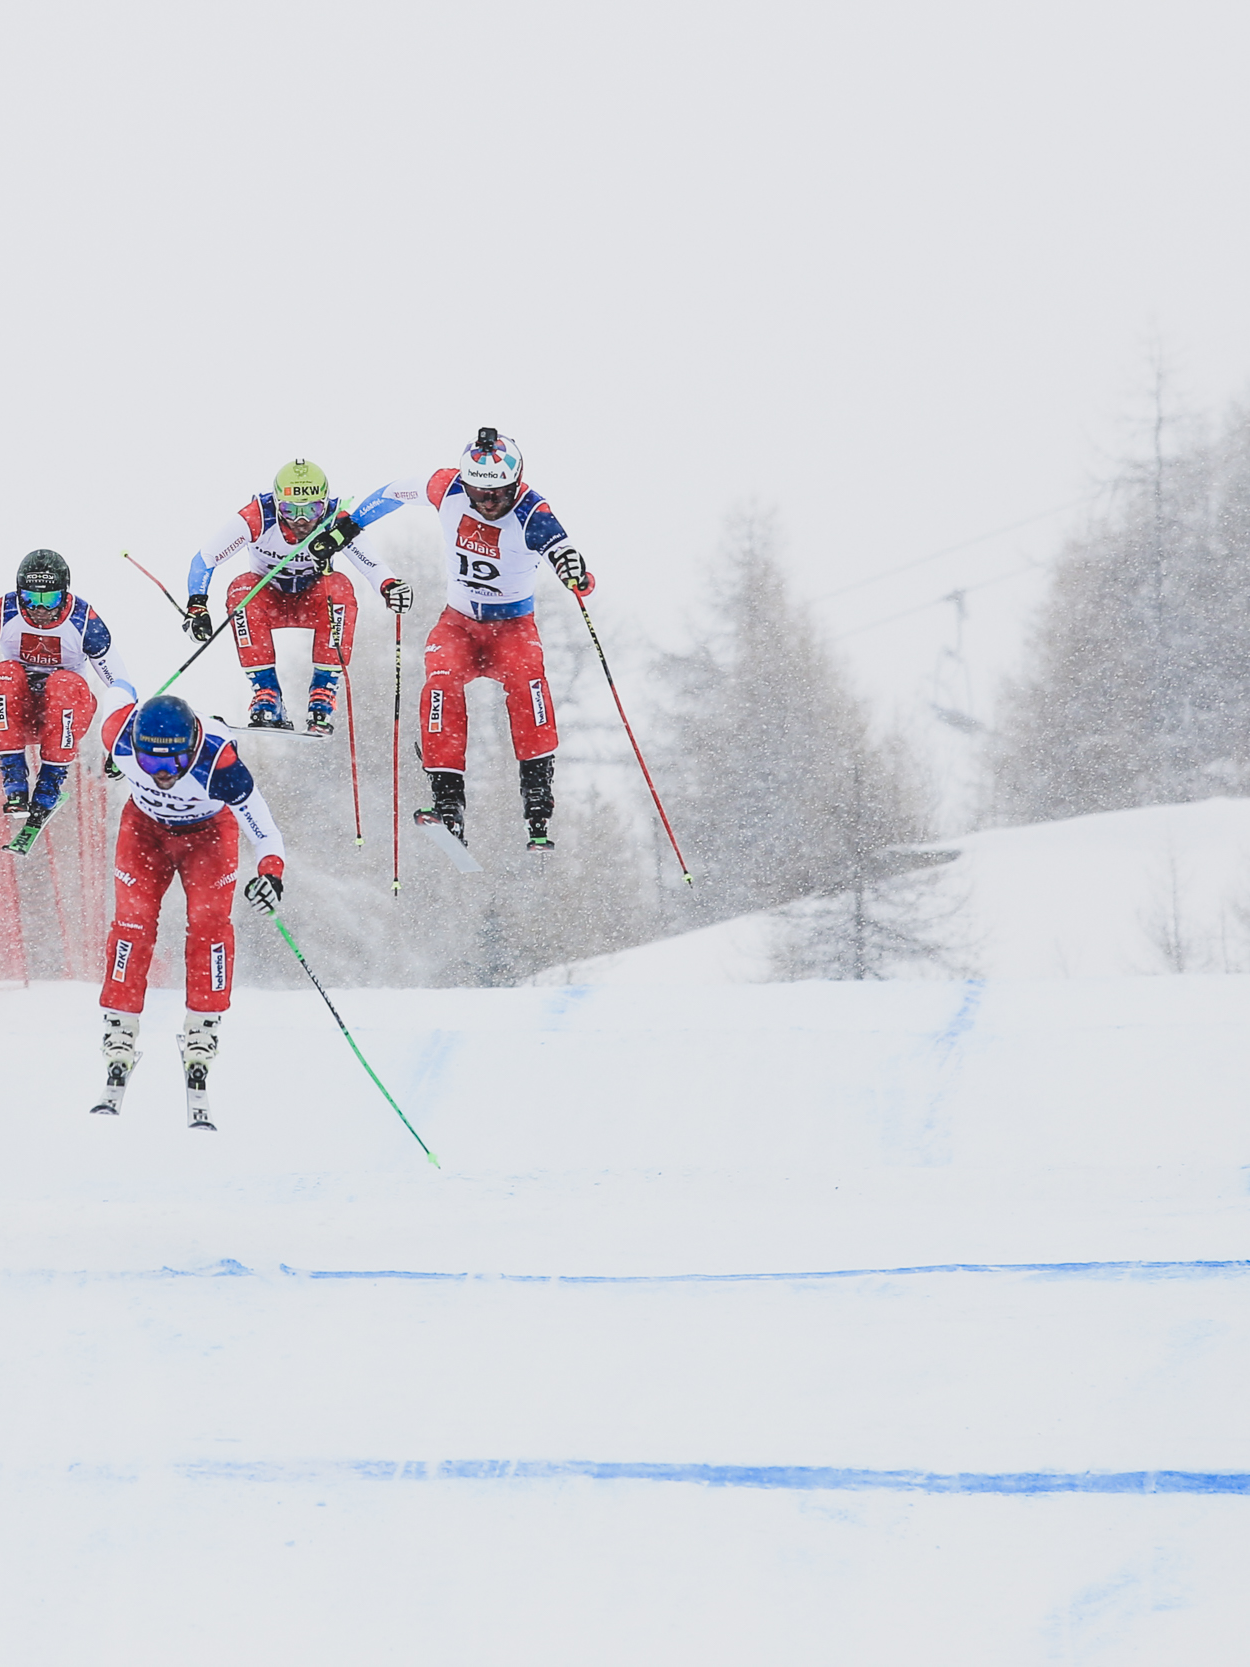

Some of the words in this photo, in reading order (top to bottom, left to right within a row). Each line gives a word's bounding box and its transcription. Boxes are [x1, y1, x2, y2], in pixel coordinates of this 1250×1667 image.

[468, 469, 498, 478] helvetia
[293, 486, 319, 495] BKW
[215, 536, 245, 562] RAIFFEISEN
[459, 536, 497, 557] Valais
[456, 552, 500, 581] 19
[21, 652, 58, 665] Valais
[431, 691, 440, 720] BKW
[215, 954, 223, 989] helvetia
